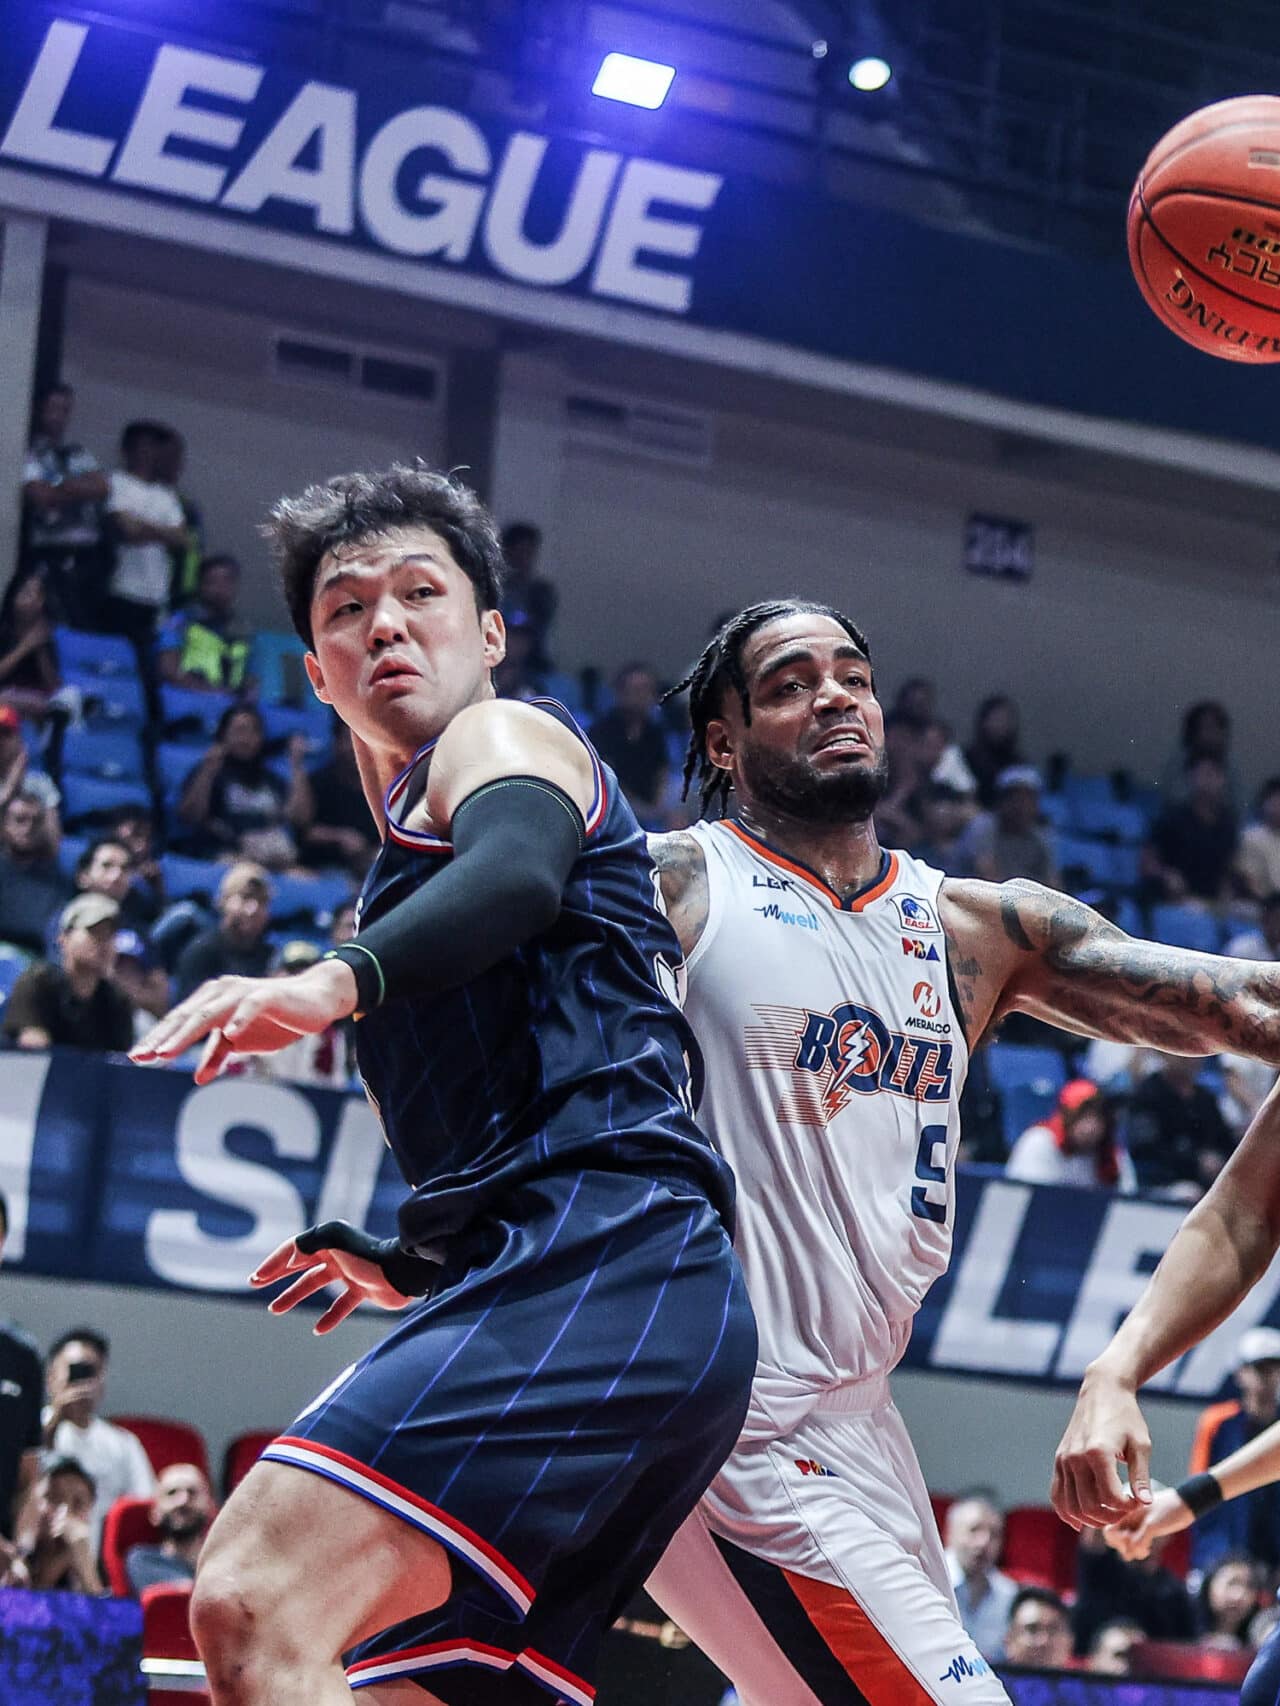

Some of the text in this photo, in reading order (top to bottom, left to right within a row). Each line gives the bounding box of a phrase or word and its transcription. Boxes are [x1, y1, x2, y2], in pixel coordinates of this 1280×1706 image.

[0, 19, 723, 313] LEAGUE
[905, 917, 934, 929] EASL
[901, 936, 941, 962] PBA
[904, 1016, 951, 1034] MERALCO
[794, 1002, 953, 1102] BOLTS
